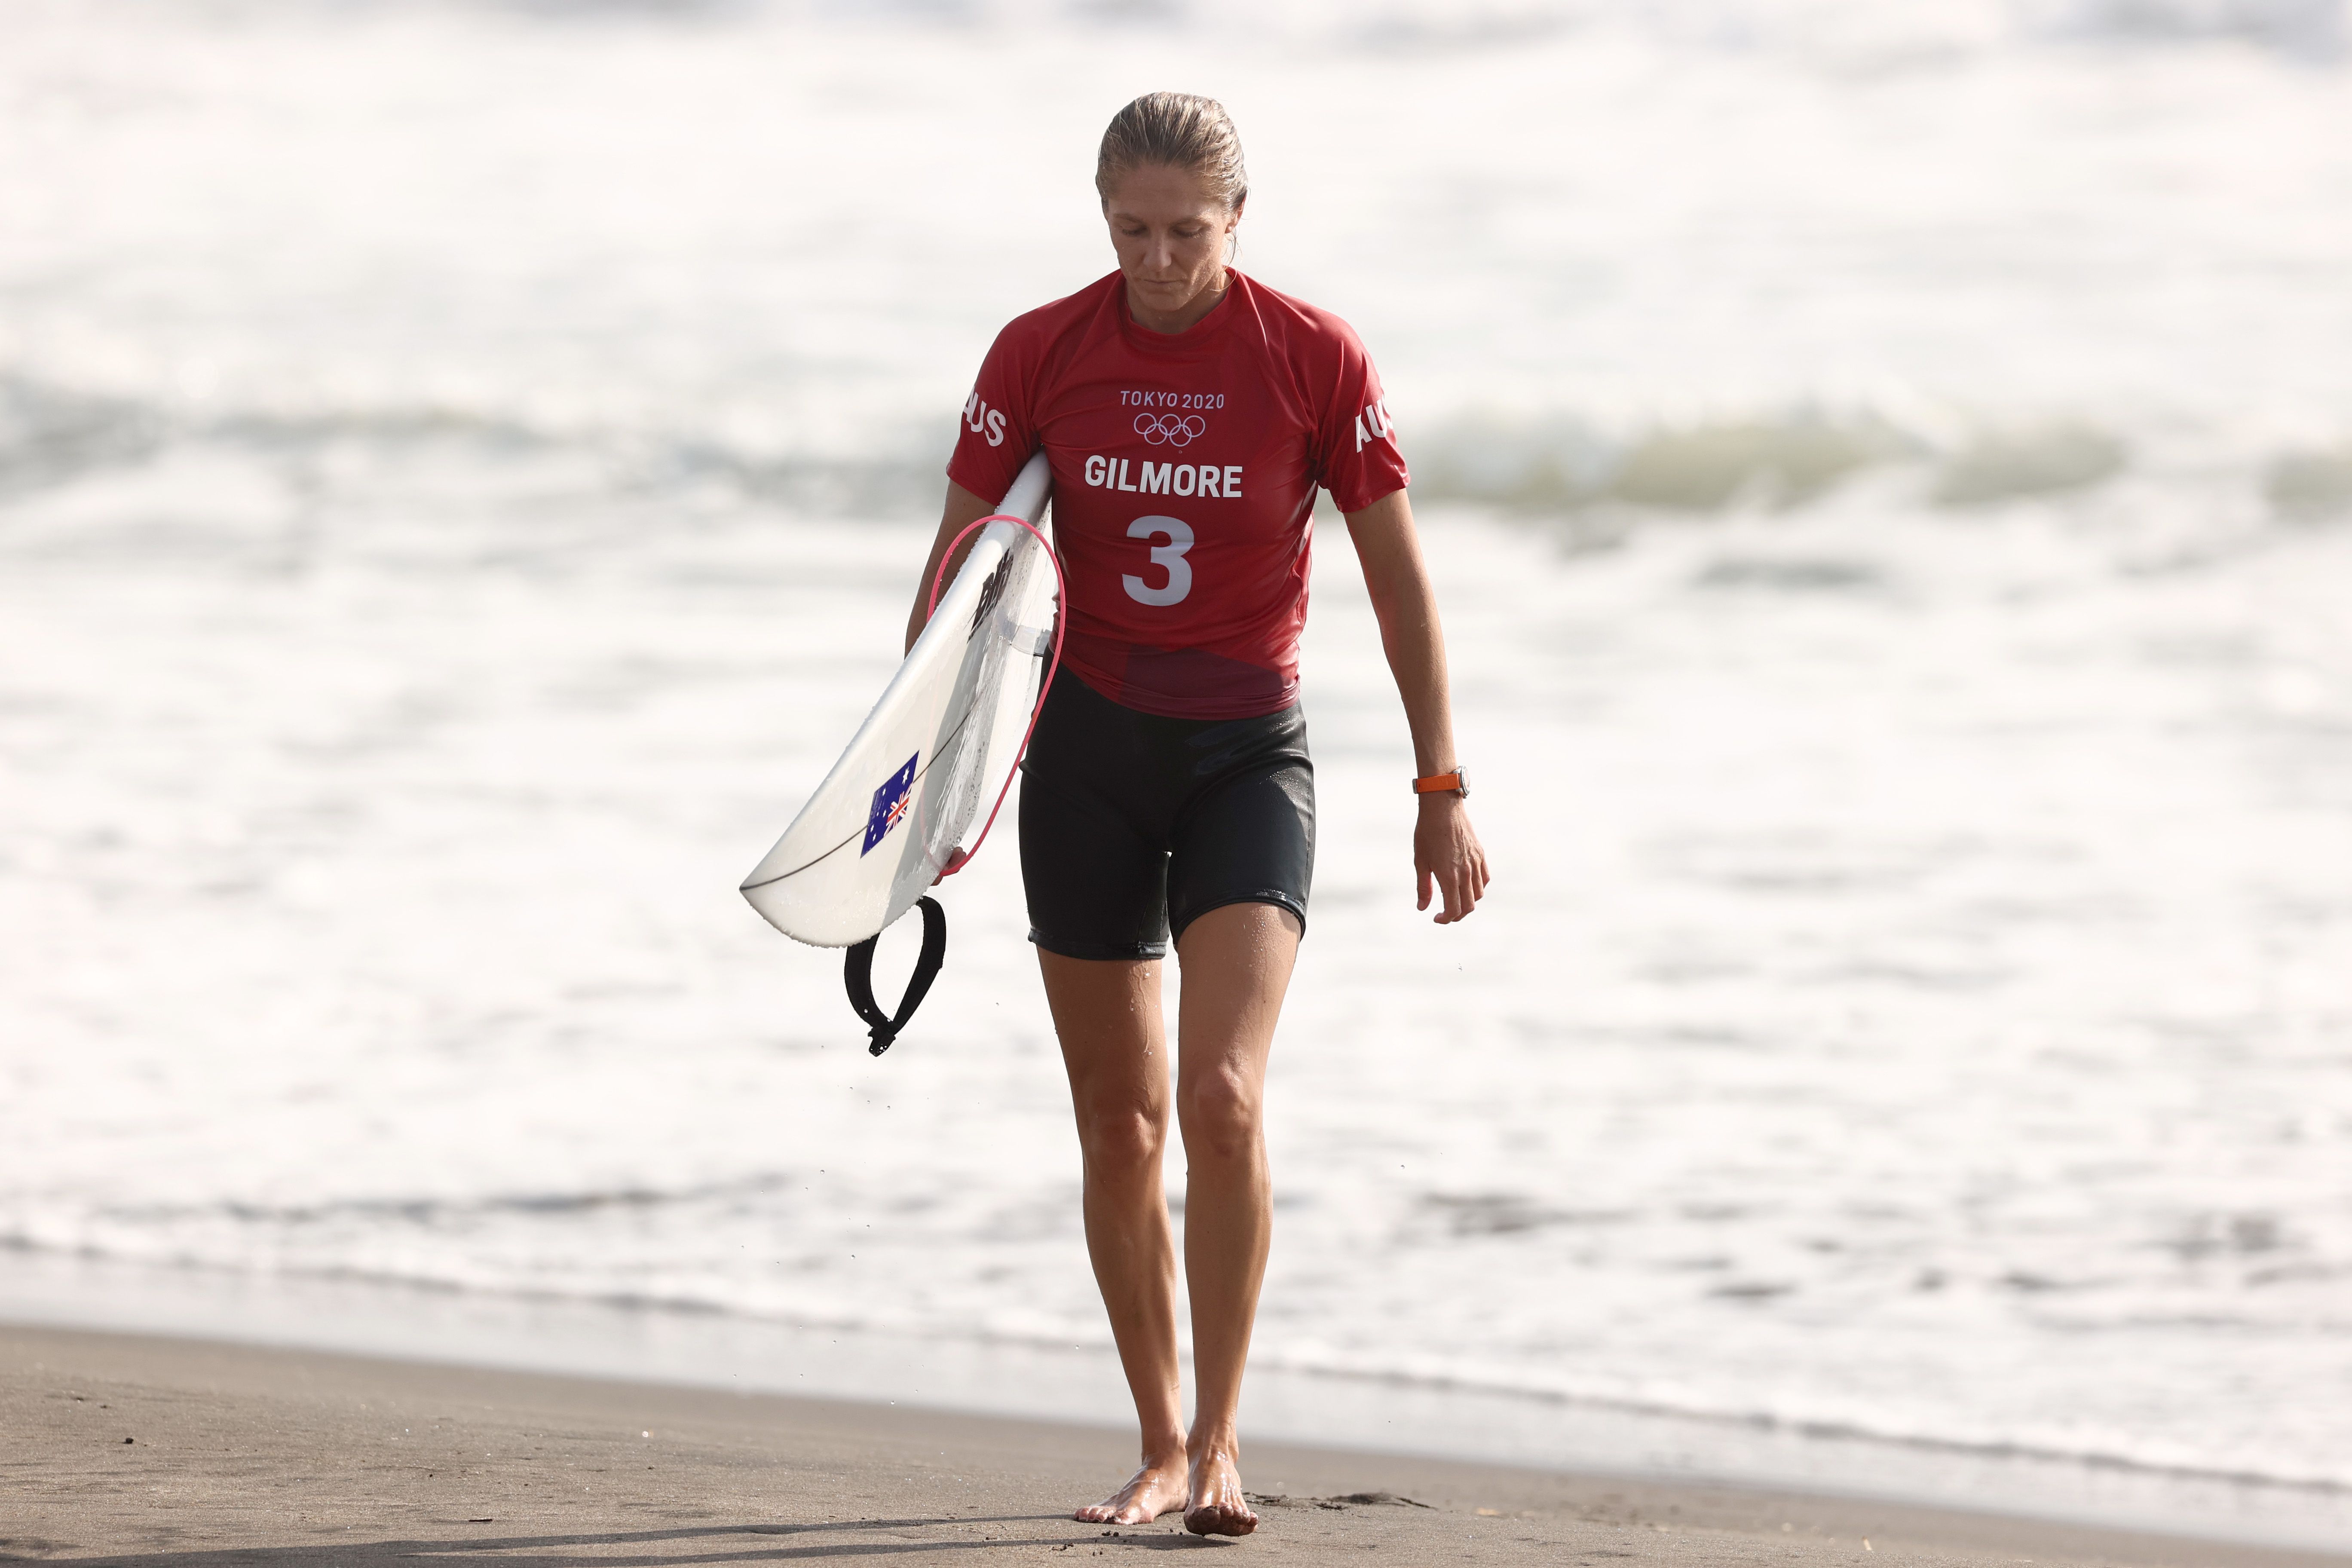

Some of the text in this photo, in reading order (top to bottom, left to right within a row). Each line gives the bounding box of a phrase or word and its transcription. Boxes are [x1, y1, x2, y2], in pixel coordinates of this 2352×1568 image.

[1120, 390, 1224, 409] TOKYO 2020
[1085, 455, 1243, 498] GILMORE
[1121, 515, 1194, 606] 3
